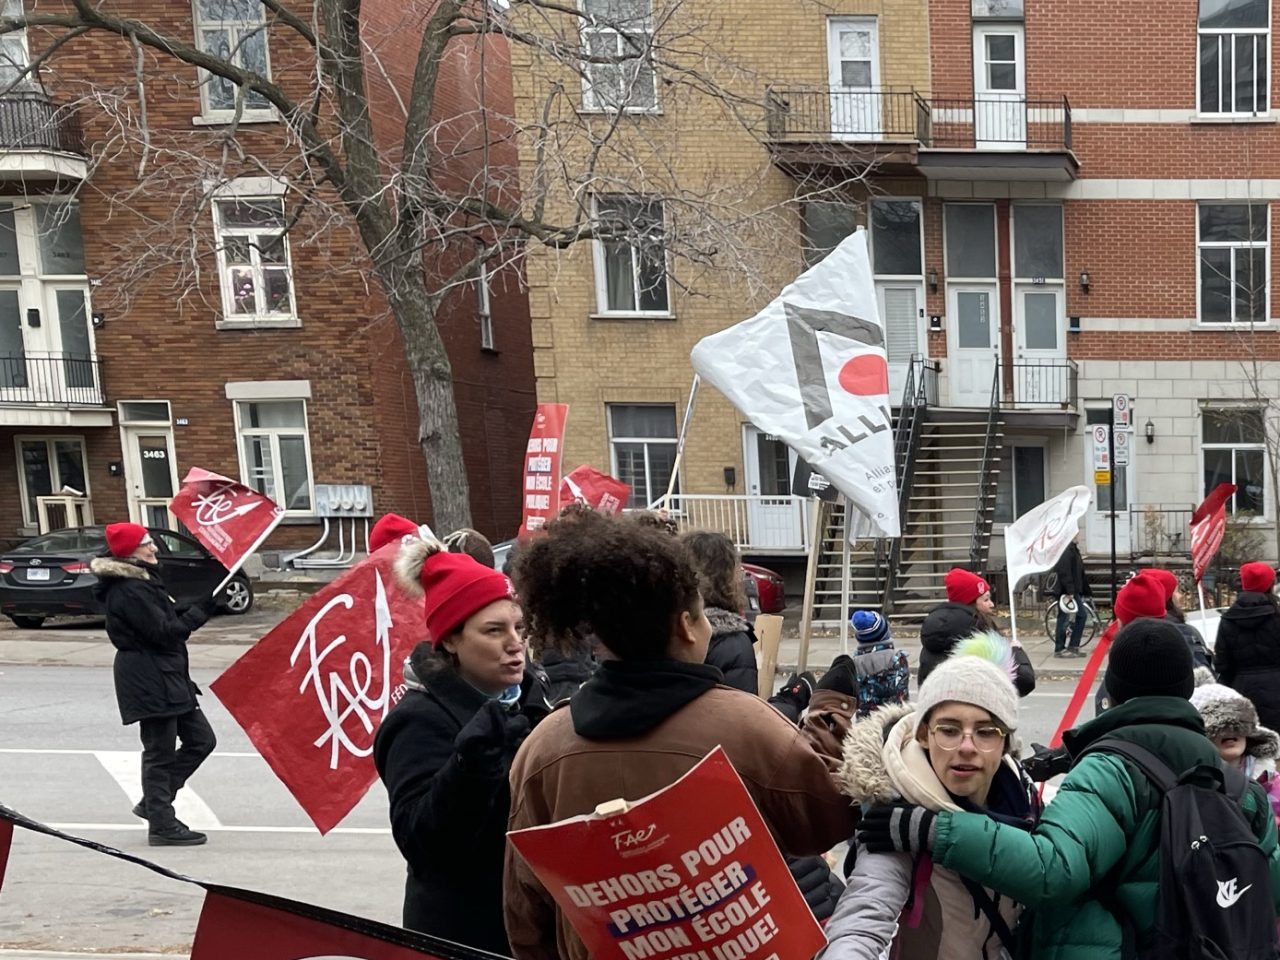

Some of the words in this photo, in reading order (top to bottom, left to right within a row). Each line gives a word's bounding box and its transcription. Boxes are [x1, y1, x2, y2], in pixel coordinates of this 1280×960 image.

[564, 863, 681, 907] DEHORS
[681, 816, 751, 877] POUR
[609, 861, 748, 933] PROTÉGER
[691, 881, 771, 943] ÉCOLE
